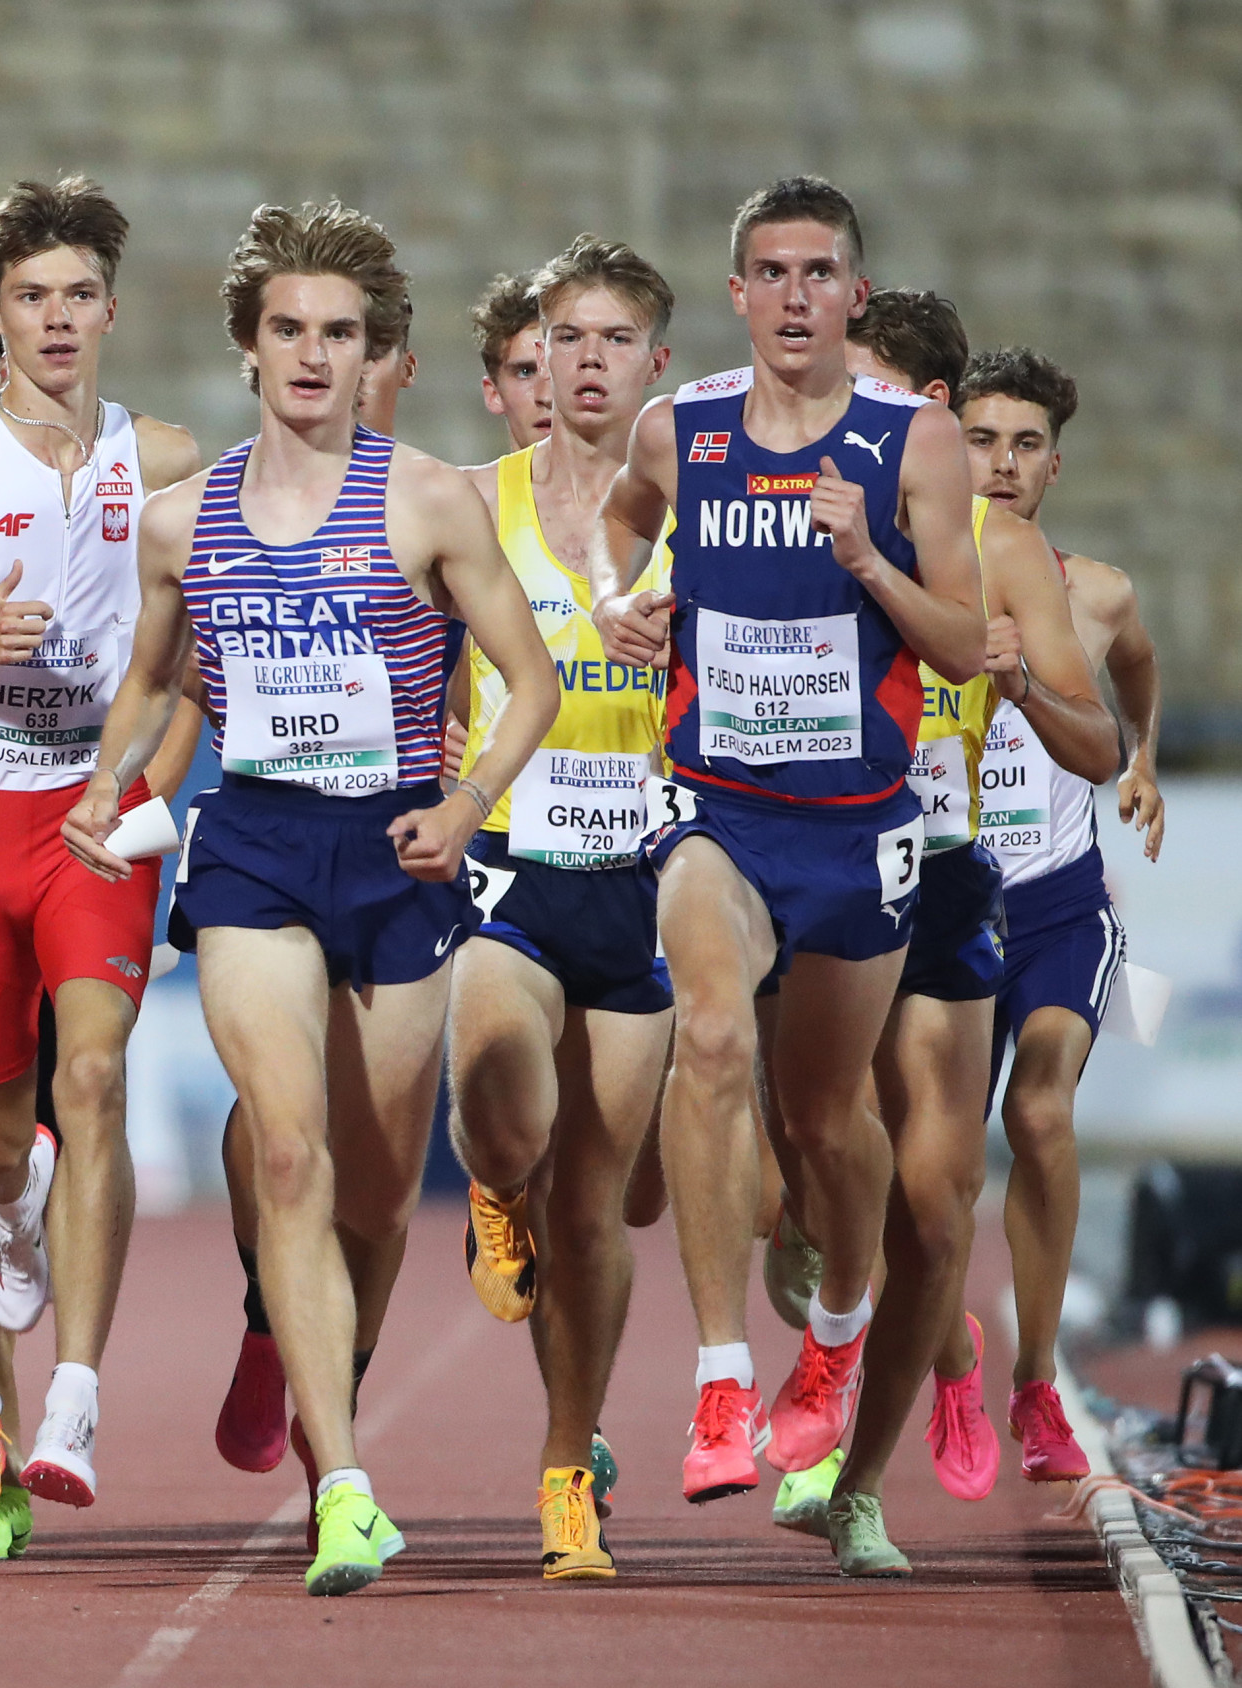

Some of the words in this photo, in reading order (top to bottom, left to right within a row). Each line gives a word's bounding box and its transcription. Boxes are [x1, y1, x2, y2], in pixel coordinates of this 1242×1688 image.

[97, 483, 131, 495] ORLEN
[773, 479, 814, 490] EXTRA
[211, 594, 366, 626] GREAT
[725, 622, 739, 641] LE
[742, 625, 813, 644] GRUYÈRE
[216, 628, 374, 658] BRITAIN
[727, 643, 809, 653] SWITZERLAND
[254, 665, 269, 683] LE
[272, 661, 342, 684] GRUYÈRE
[259, 684, 339, 694] SWITZERLAND
[708, 666, 745, 695] FJELD
[750, 671, 850, 696] HALVORSEN
[755, 701, 789, 717] 612
[26, 713, 58, 728] 638
[271, 713, 339, 737] BIRD
[735, 718, 762, 733] RUN
[765, 719, 819, 732] CLEAN
[34, 730, 80, 744] CLEAN
[710, 733, 802, 757] JERUSALEM
[807, 736, 852, 752] 2023
[289, 741, 324, 755] 382
[262, 759, 298, 773] RUN
[300, 754, 354, 769] CLEAN
[551, 757, 569, 774] LE
[572, 756, 636, 778] GRUYÈRE
[345, 773, 388, 789] 2023
[554, 777, 632, 788] SWITZERLAND
[662, 785, 681, 825] 3
[547, 805, 639, 830] GRAHN
[581, 834, 613, 850] 720
[1000, 830, 1041, 847] 2023
[553, 852, 586, 866] RUN
[896, 838, 913, 884] 3
